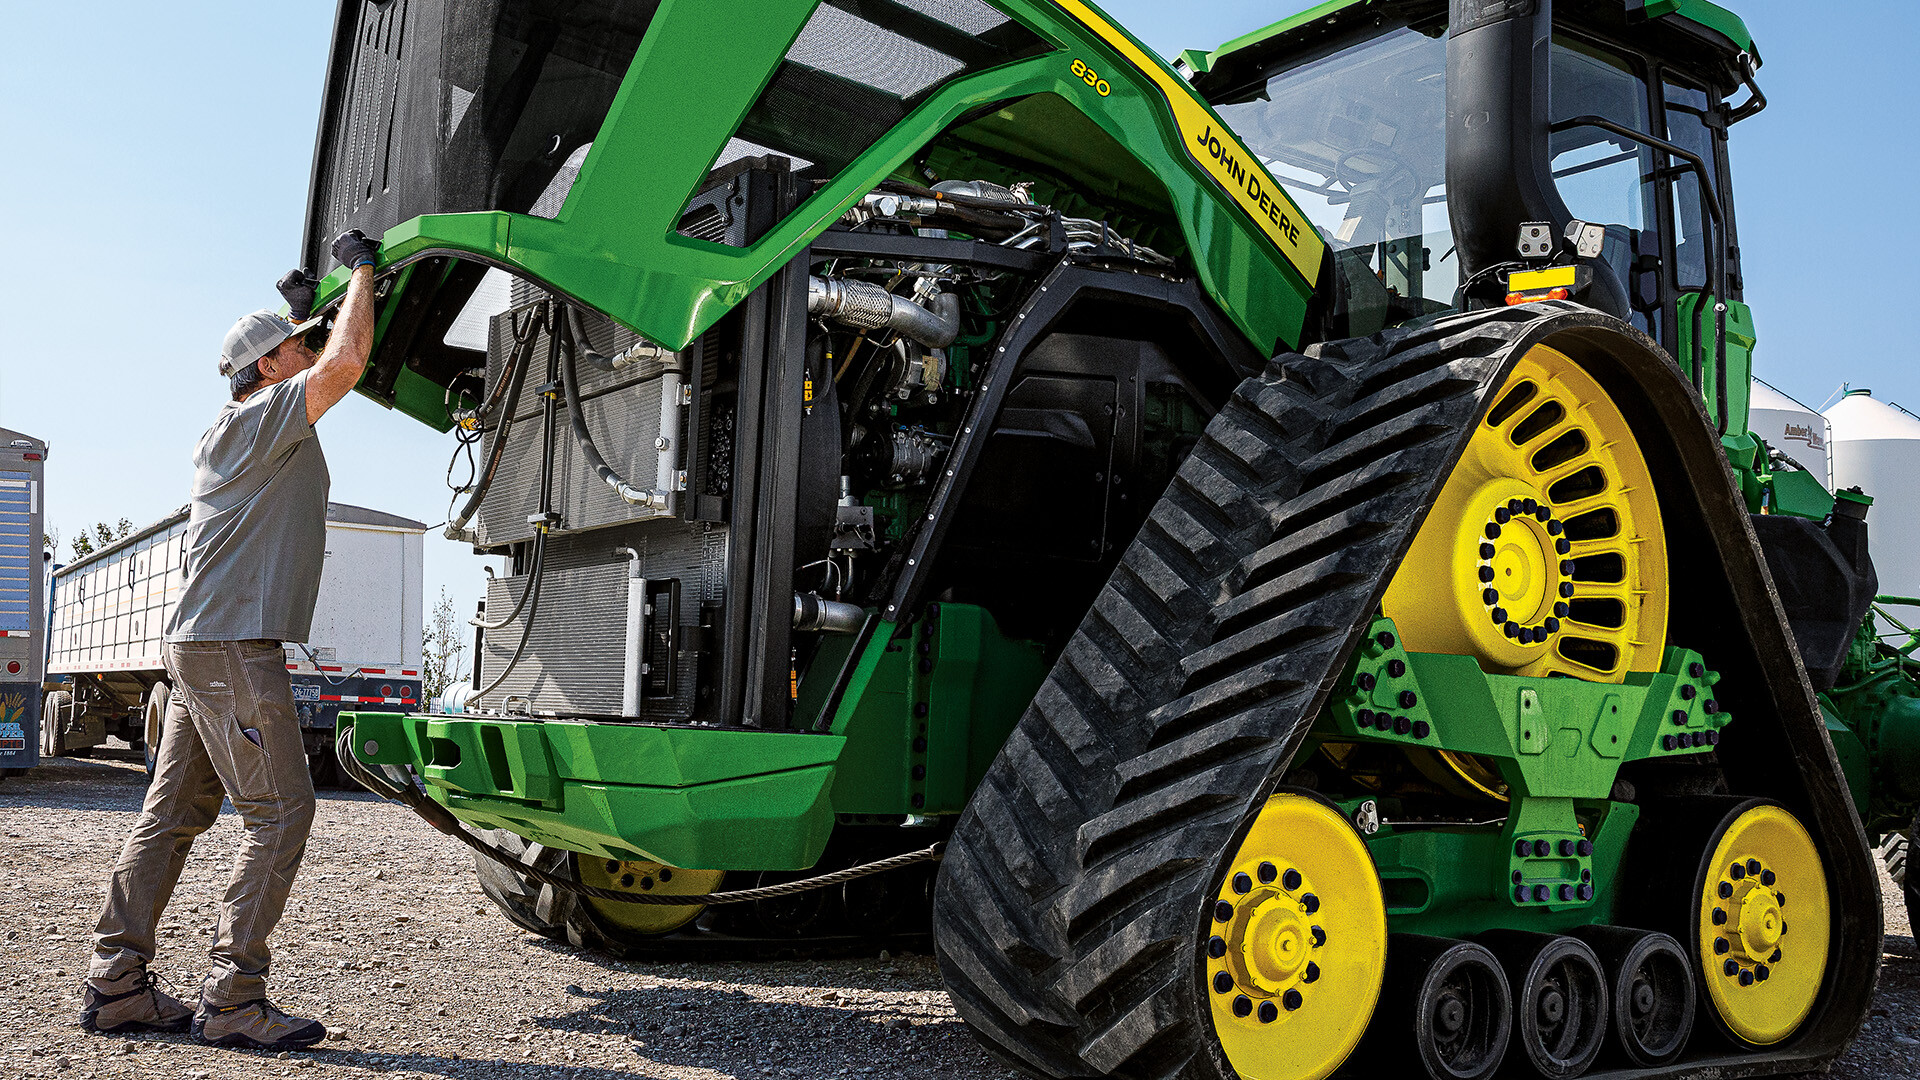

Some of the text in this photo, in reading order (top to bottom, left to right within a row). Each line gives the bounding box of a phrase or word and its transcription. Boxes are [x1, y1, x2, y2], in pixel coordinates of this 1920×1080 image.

[1070, 58, 1111, 97] 830
[1197, 125, 1300, 248] JOHN DEERE
